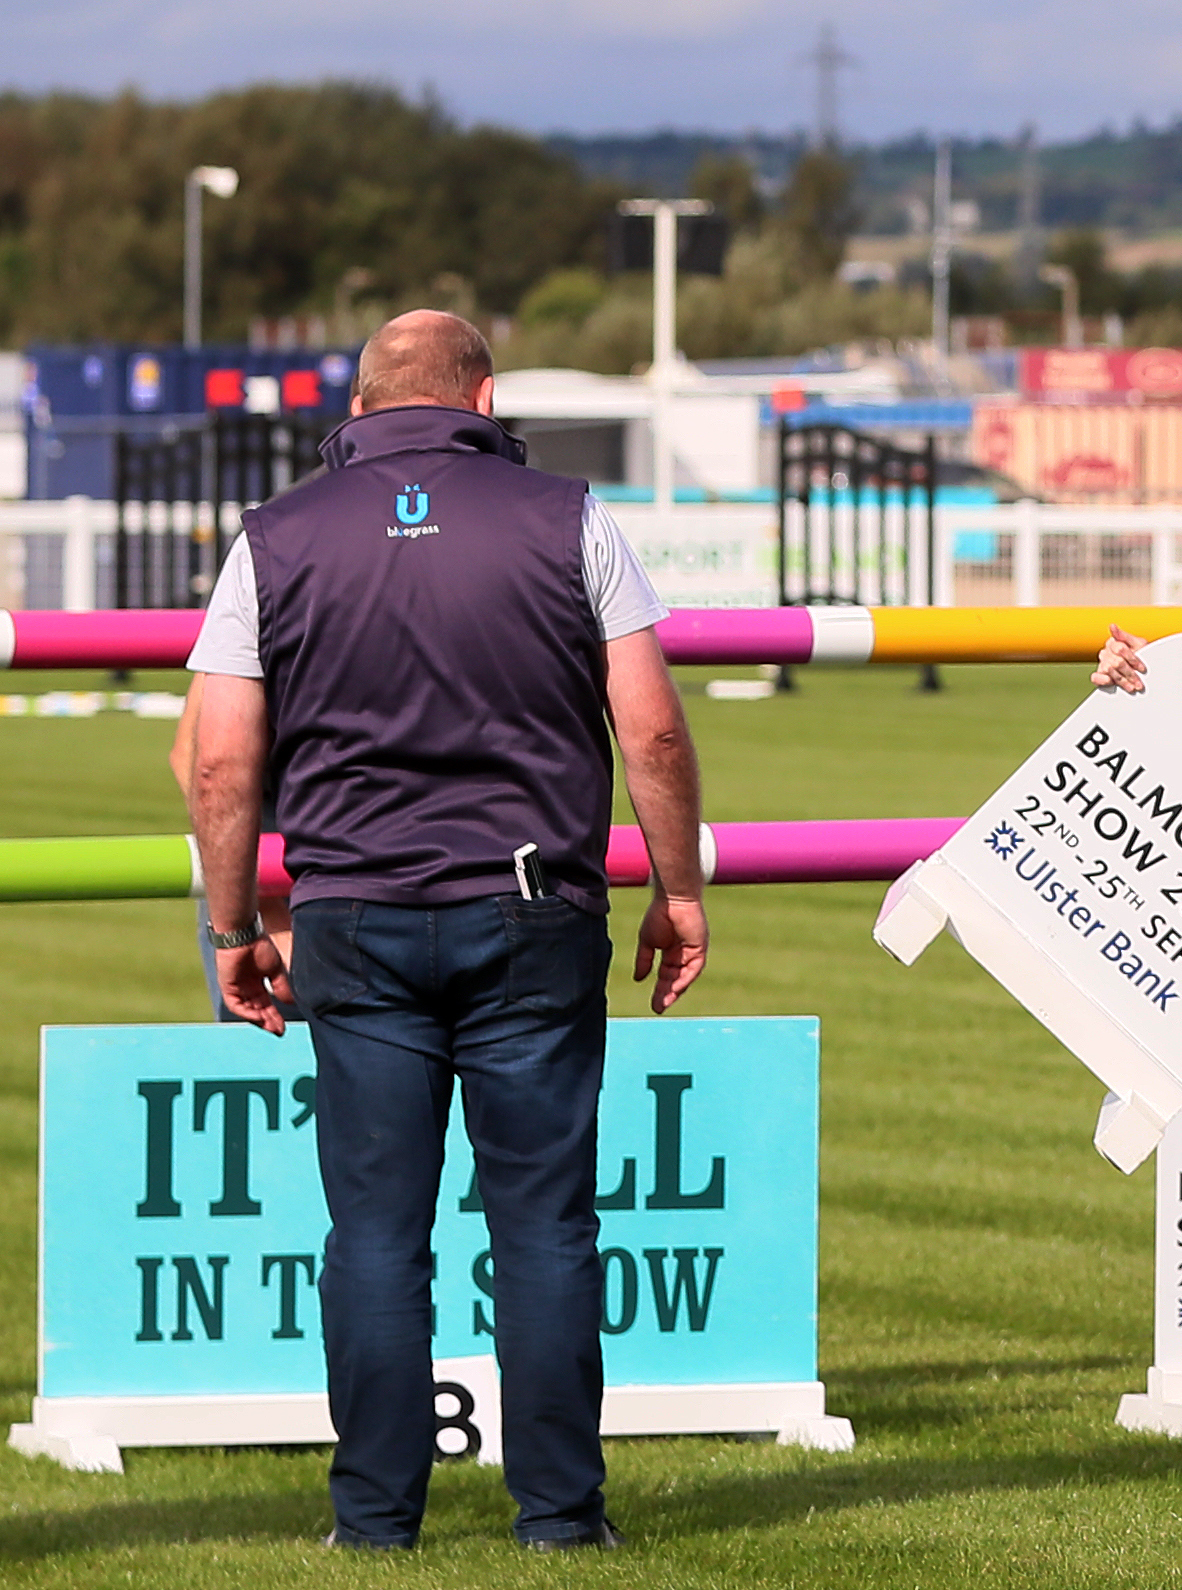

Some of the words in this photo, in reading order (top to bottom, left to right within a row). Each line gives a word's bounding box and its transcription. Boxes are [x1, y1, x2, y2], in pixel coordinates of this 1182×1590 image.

[386, 524, 440, 539] bluegrass
[1043, 761, 1166, 873] SHOW
[1015, 848, 1105, 938] Ulster
[1100, 930, 1181, 1013] Bank
[136, 1075, 316, 1217] IT'
[135, 1255, 230, 1341] IN
[433, 1381, 482, 1462] 8
